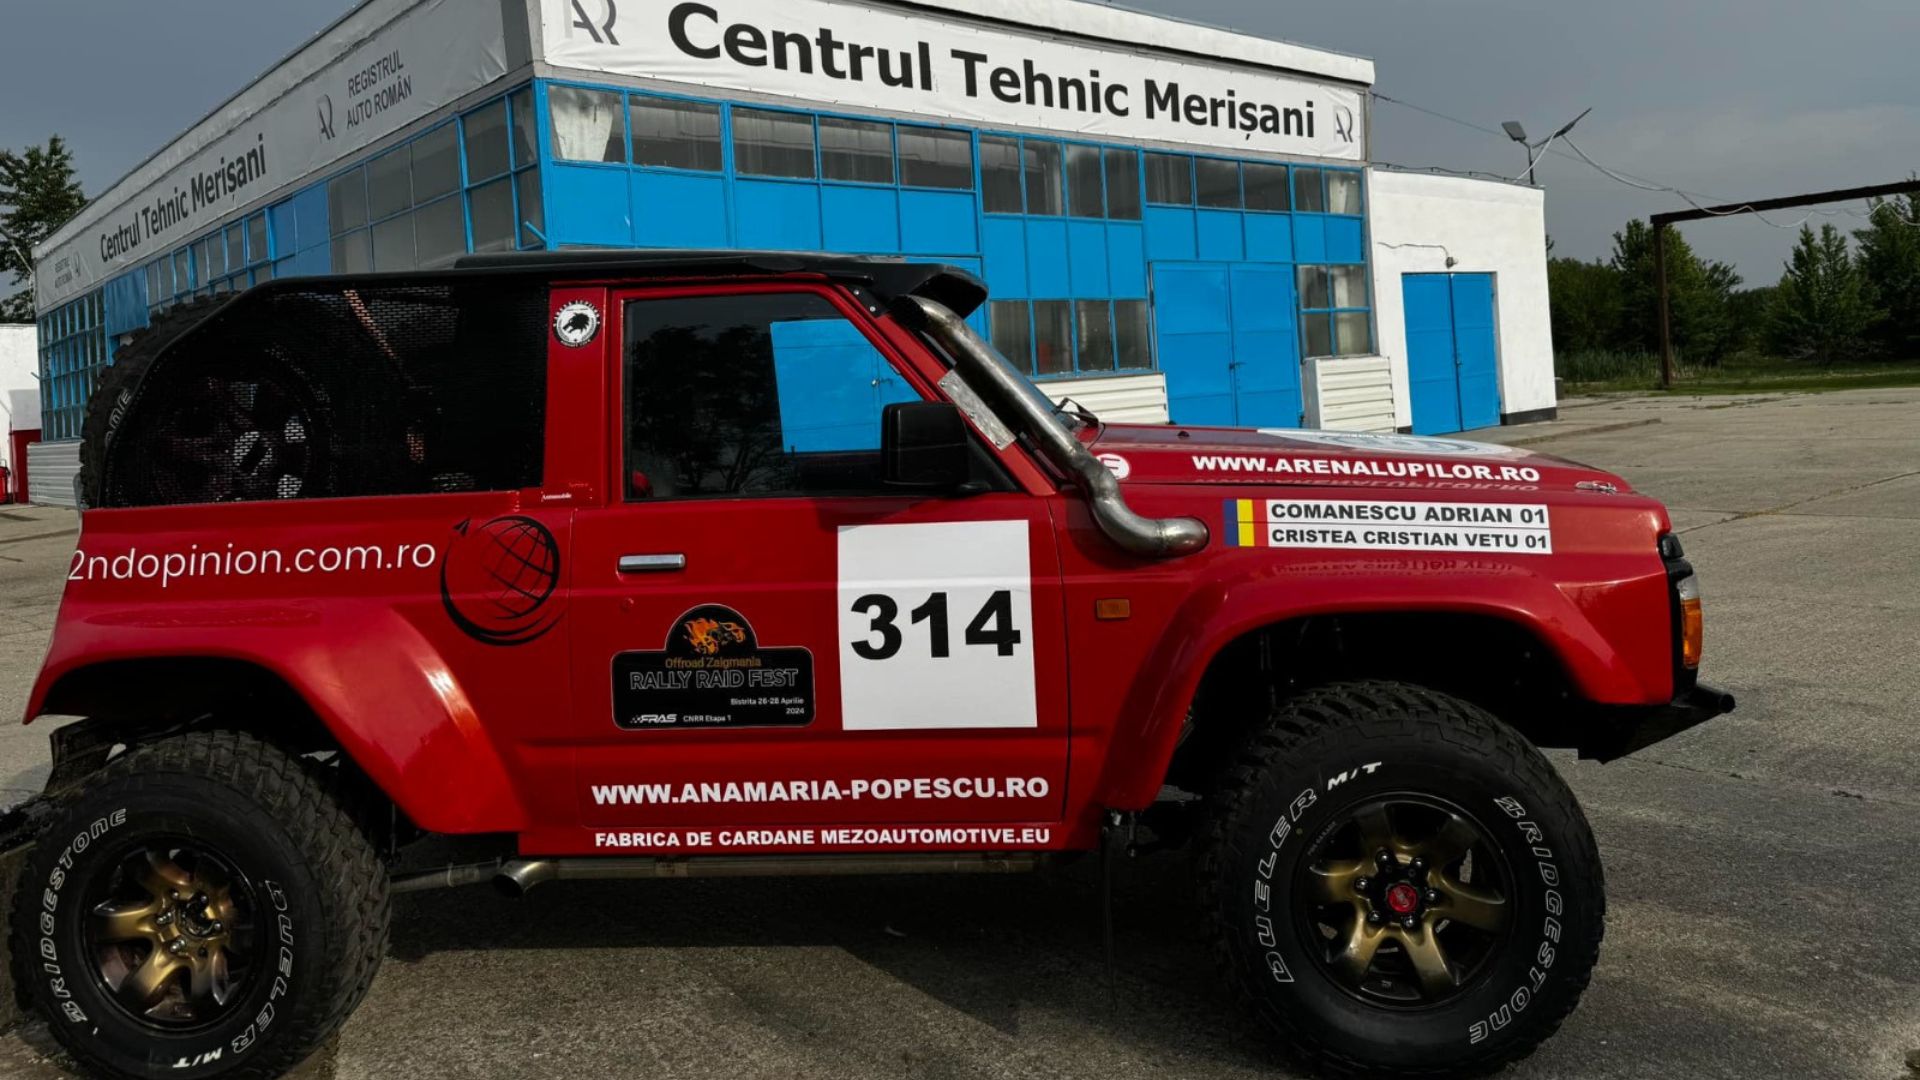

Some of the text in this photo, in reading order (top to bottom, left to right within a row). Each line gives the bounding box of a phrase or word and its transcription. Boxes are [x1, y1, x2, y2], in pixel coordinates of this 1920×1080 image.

[348, 49, 404, 99] REGISTRUL
[668, 2, 1315, 140] Centrul Tehnic Merișani
[347, 75, 412, 131] AUTO ROMÂN
[100, 213, 141, 263] Centrul
[142, 187, 189, 240] Tehnic
[1192, 454, 1540, 483] WWW.ARENALUPILOR.RO
[1271, 502, 1546, 526] COMANESCU ADRIAN 01
[1271, 528, 1547, 550] CRISTEA CRISTIAN VETU 01
[68, 540, 437, 588] 2ndopinion.com.ro
[850, 590, 1021, 660] 314
[630, 668, 799, 690] RALLY RAID FEST
[665, 657, 704, 668] Offroad
[591, 777, 1050, 806] WWW.ANAMARIA-POPESCU.RO
[594, 828, 1051, 847] FABRICA DE CARDANE MEZOAUTOMOTIVE.EU
[1254, 761, 1382, 984] DUELER M/T
[40, 808, 127, 1024] BRIDGESTONE
[1469, 796, 1563, 1045] BRIDGESTONE
[172, 878, 294, 1070] DUELER M/T
